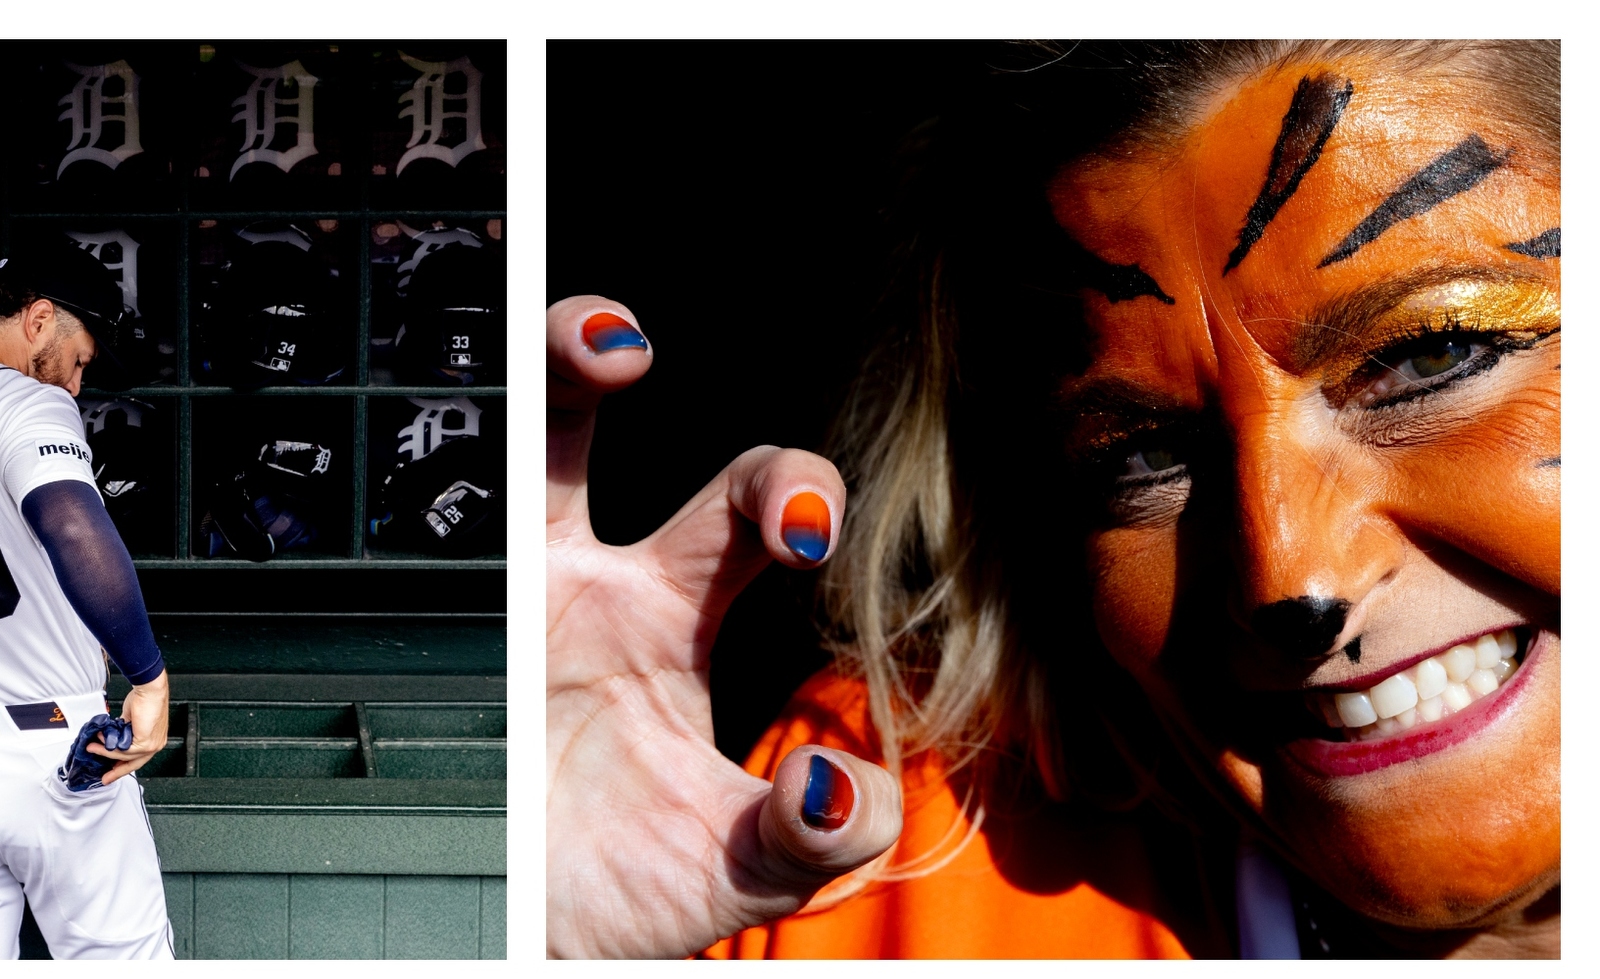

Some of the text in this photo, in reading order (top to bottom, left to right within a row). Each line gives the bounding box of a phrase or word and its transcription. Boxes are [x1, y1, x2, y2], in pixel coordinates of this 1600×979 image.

[277, 341, 296, 357] 34
[451, 336, 470, 349] 33
[38, 442, 90, 464] meije
[443, 505, 464, 524] 25
